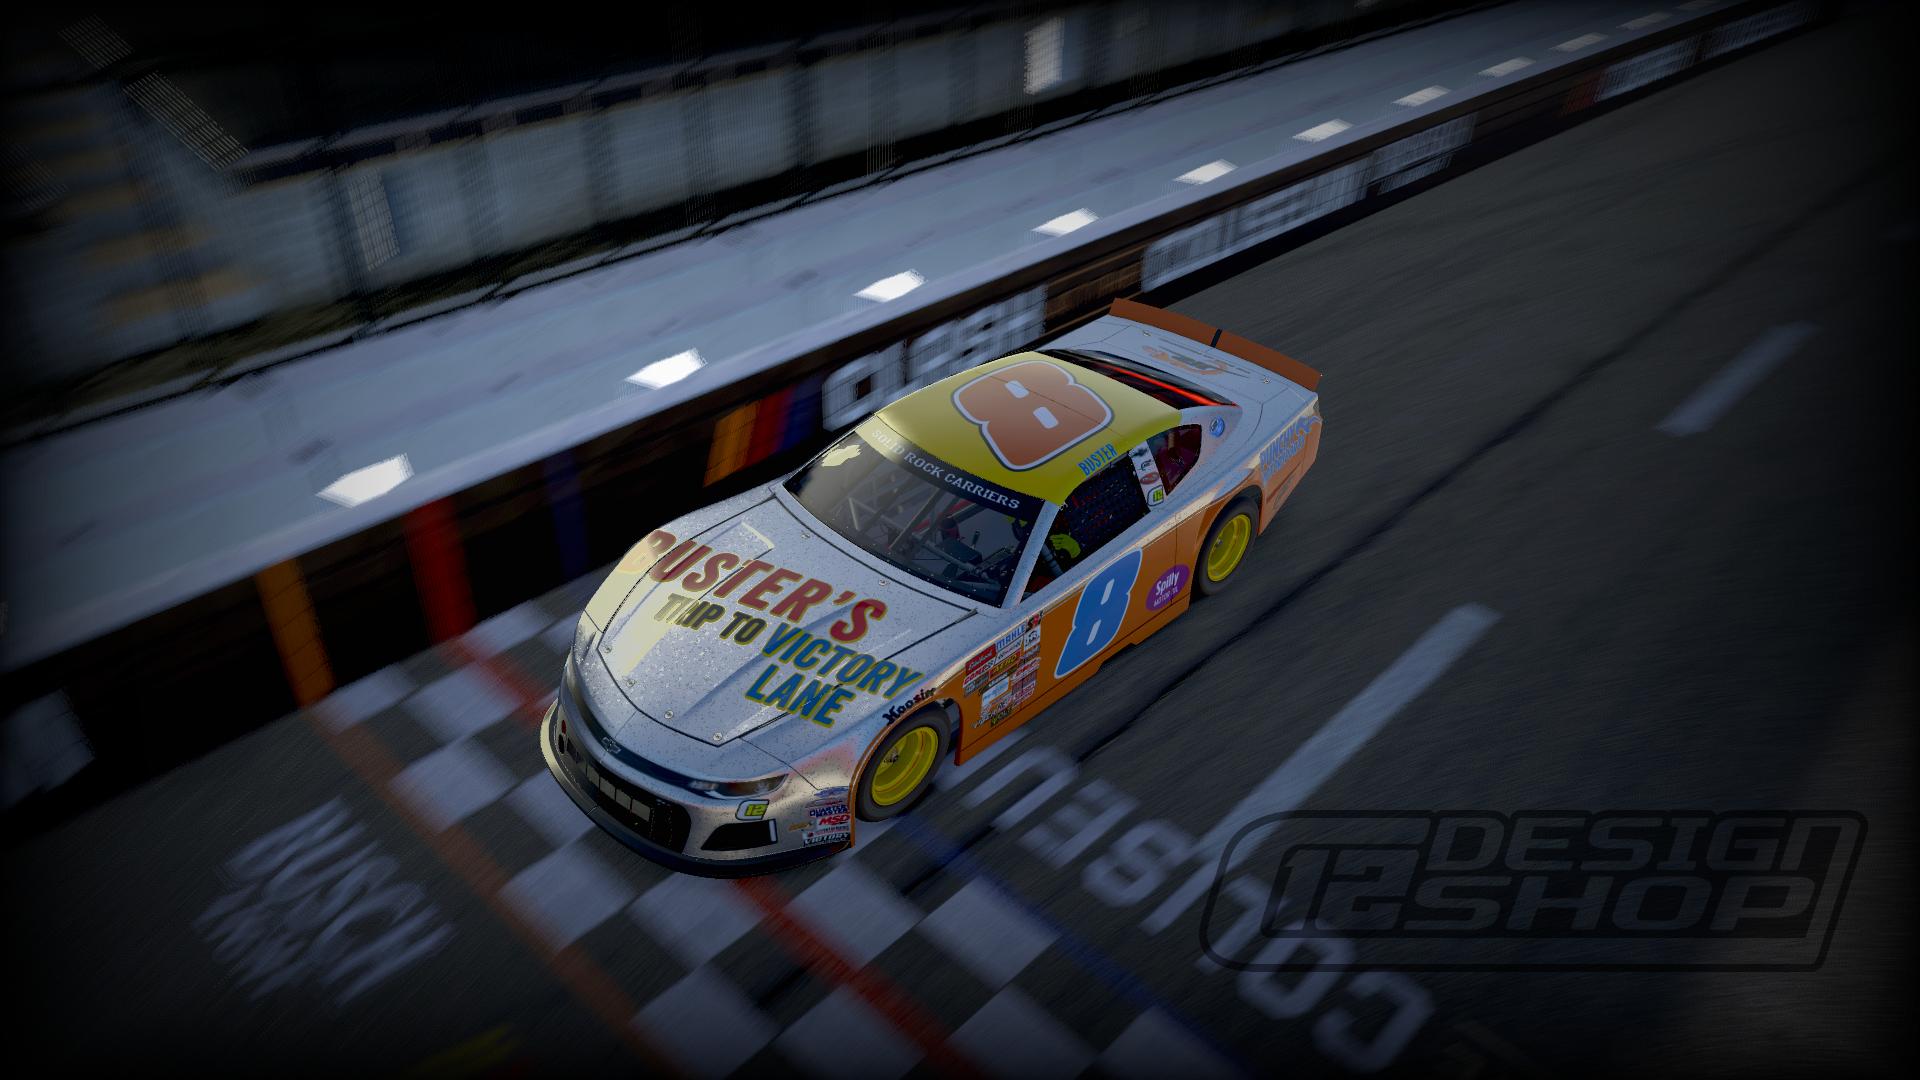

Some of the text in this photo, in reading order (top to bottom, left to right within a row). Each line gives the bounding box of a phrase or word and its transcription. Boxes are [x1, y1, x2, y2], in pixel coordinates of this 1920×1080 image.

[952, 360, 1115, 471] 8
[872, 430, 1020, 509] SOLID ROCK CARRIERS
[1077, 443, 1118, 478] BUSTER
[616, 529, 888, 643] BUSTER'S
[1054, 547, 1143, 680] 8
[1156, 571, 1180, 596] Spilly
[719, 611, 767, 645] TO
[996, 625, 1026, 650] MAHLE
[762, 622, 925, 700] VICTORY
[745, 664, 856, 729] LANE
[819, 814, 850, 826] MSD
